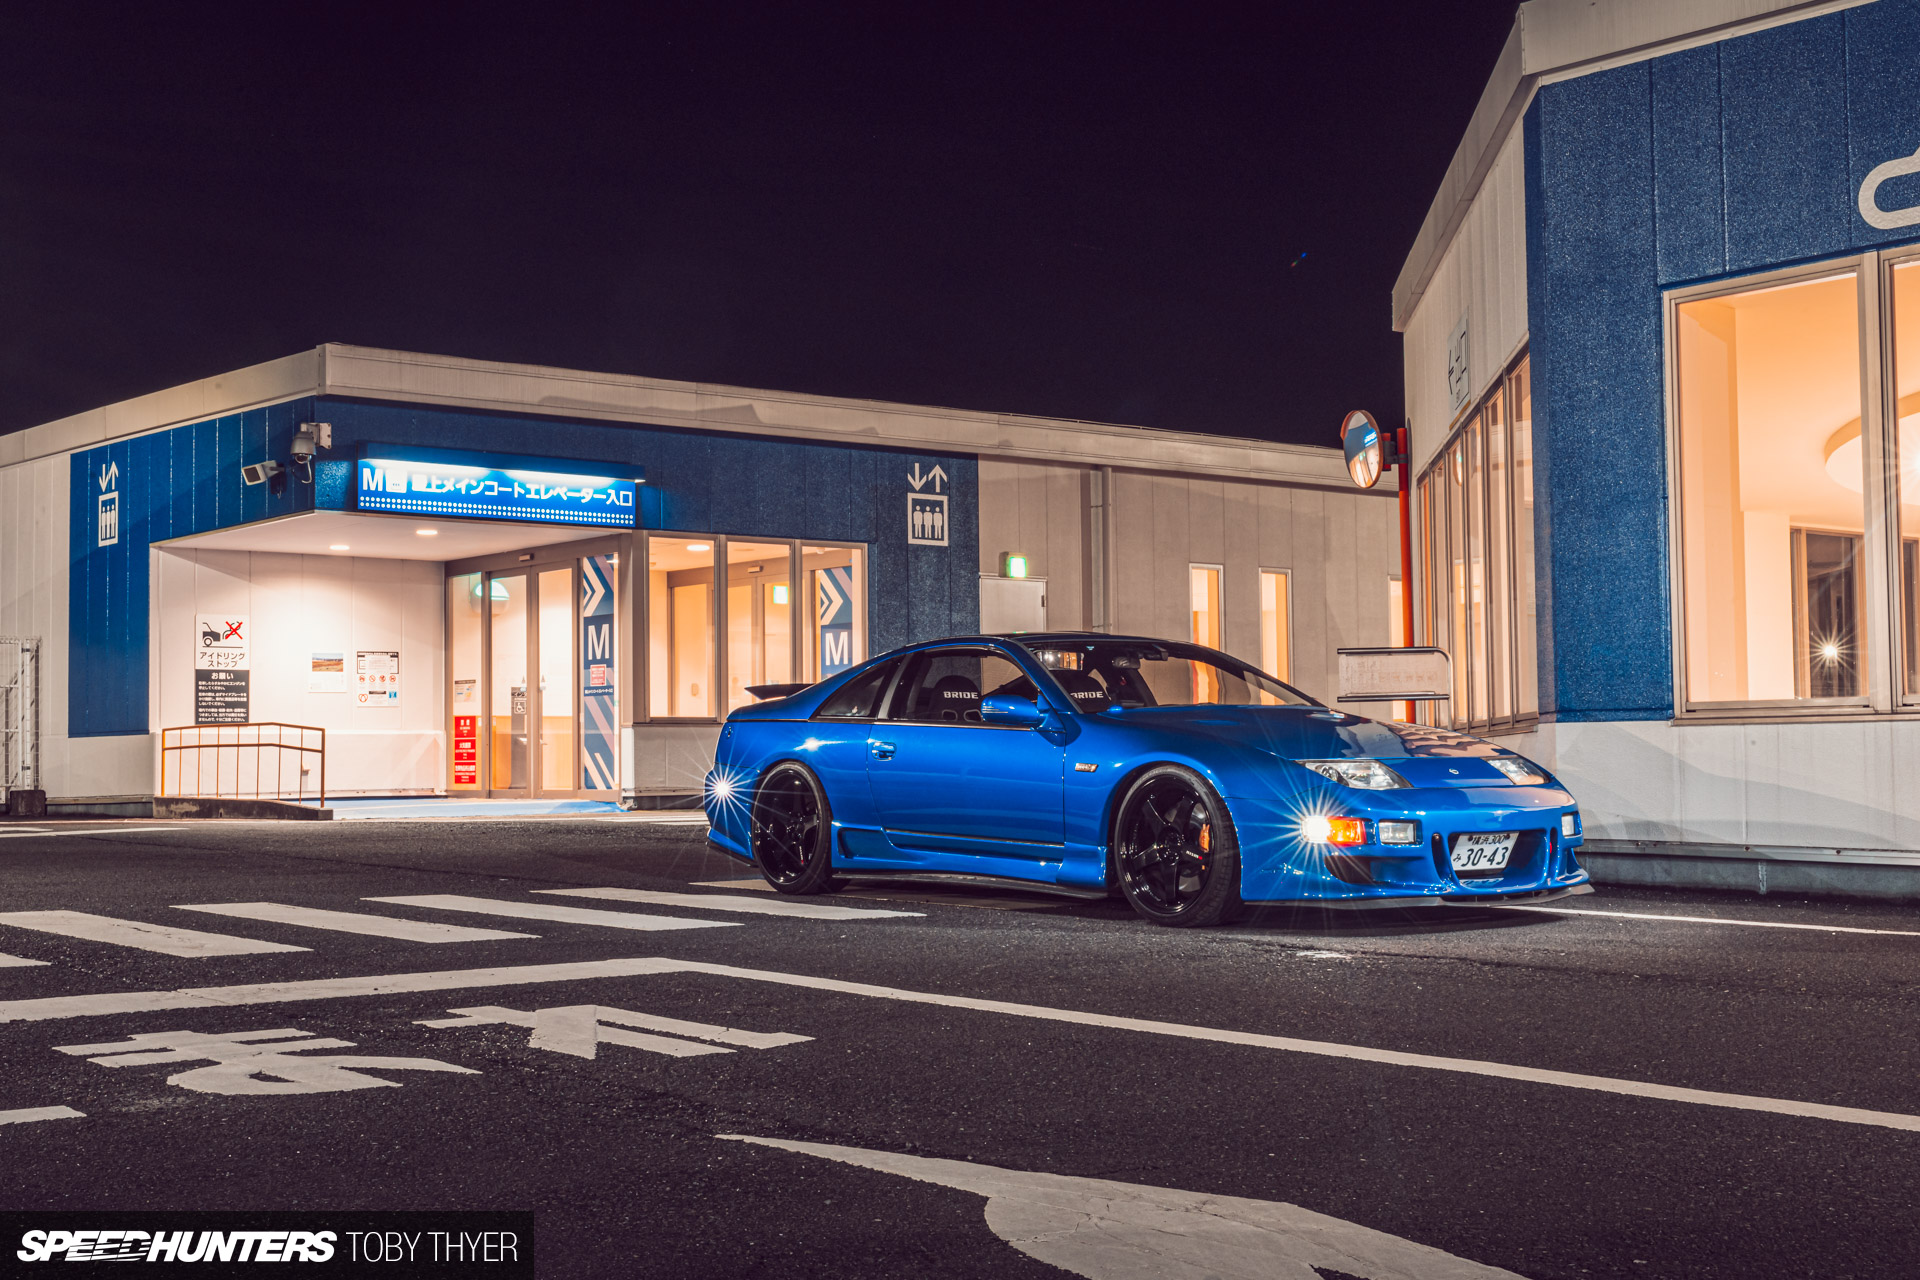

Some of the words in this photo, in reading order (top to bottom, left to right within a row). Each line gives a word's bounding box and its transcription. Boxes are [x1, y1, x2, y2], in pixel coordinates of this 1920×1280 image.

[362, 468, 384, 491] M
[411, 473, 633, 507] 上メインコートエレベーター入口
[200, 652, 245, 660] アイドリング
[588, 624, 610, 660] M
[825, 631, 849, 666] M
[943, 690, 979, 700] BRIDE
[1453, 854, 1461, 862] み
[1461, 846, 1509, 867] 30-43
